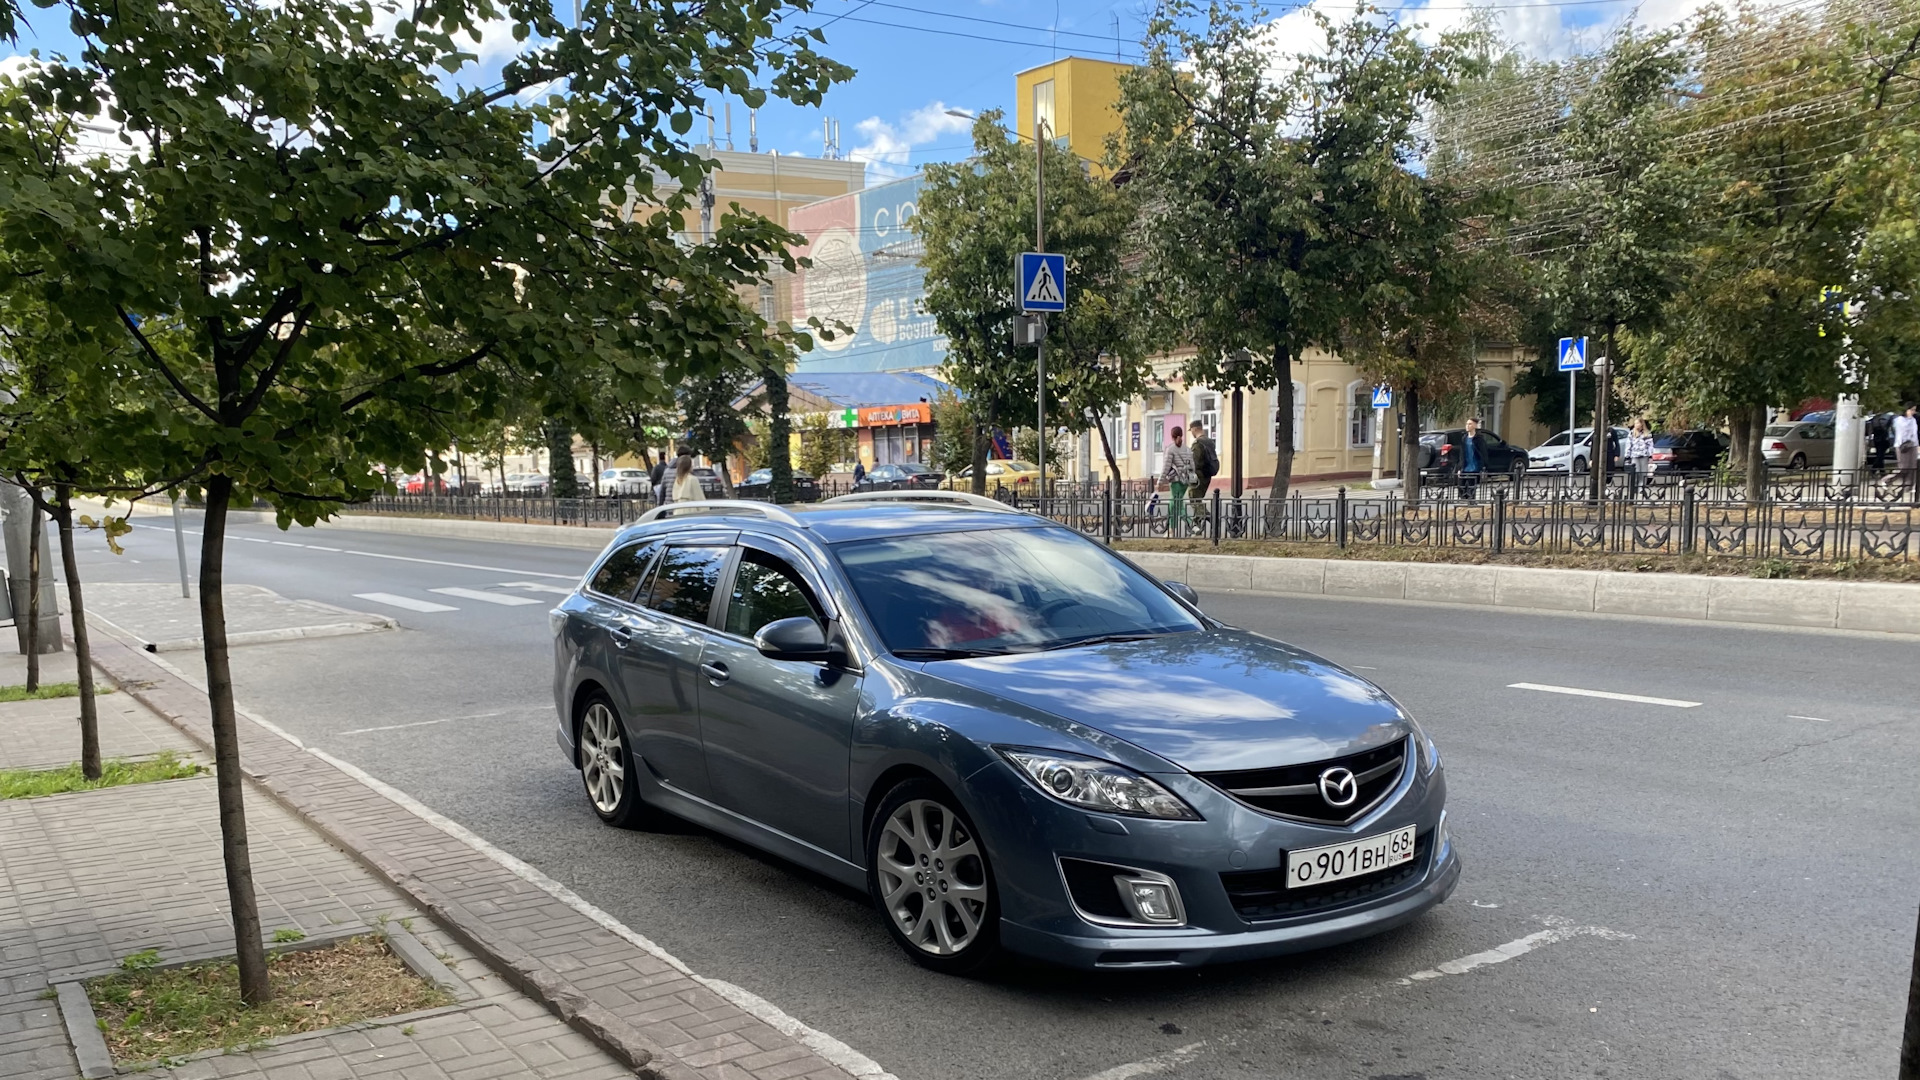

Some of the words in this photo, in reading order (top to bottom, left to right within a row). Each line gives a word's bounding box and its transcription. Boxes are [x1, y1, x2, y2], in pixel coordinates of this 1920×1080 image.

[874, 201, 920, 237] СЮ
[868, 411, 894, 422] АПТЕКА
[901, 408, 920, 419] ВИТА
[1297, 845, 1386, 881] О901ВН
[1392, 832, 1409, 853] 68
[1389, 852, 1403, 863] RUS
